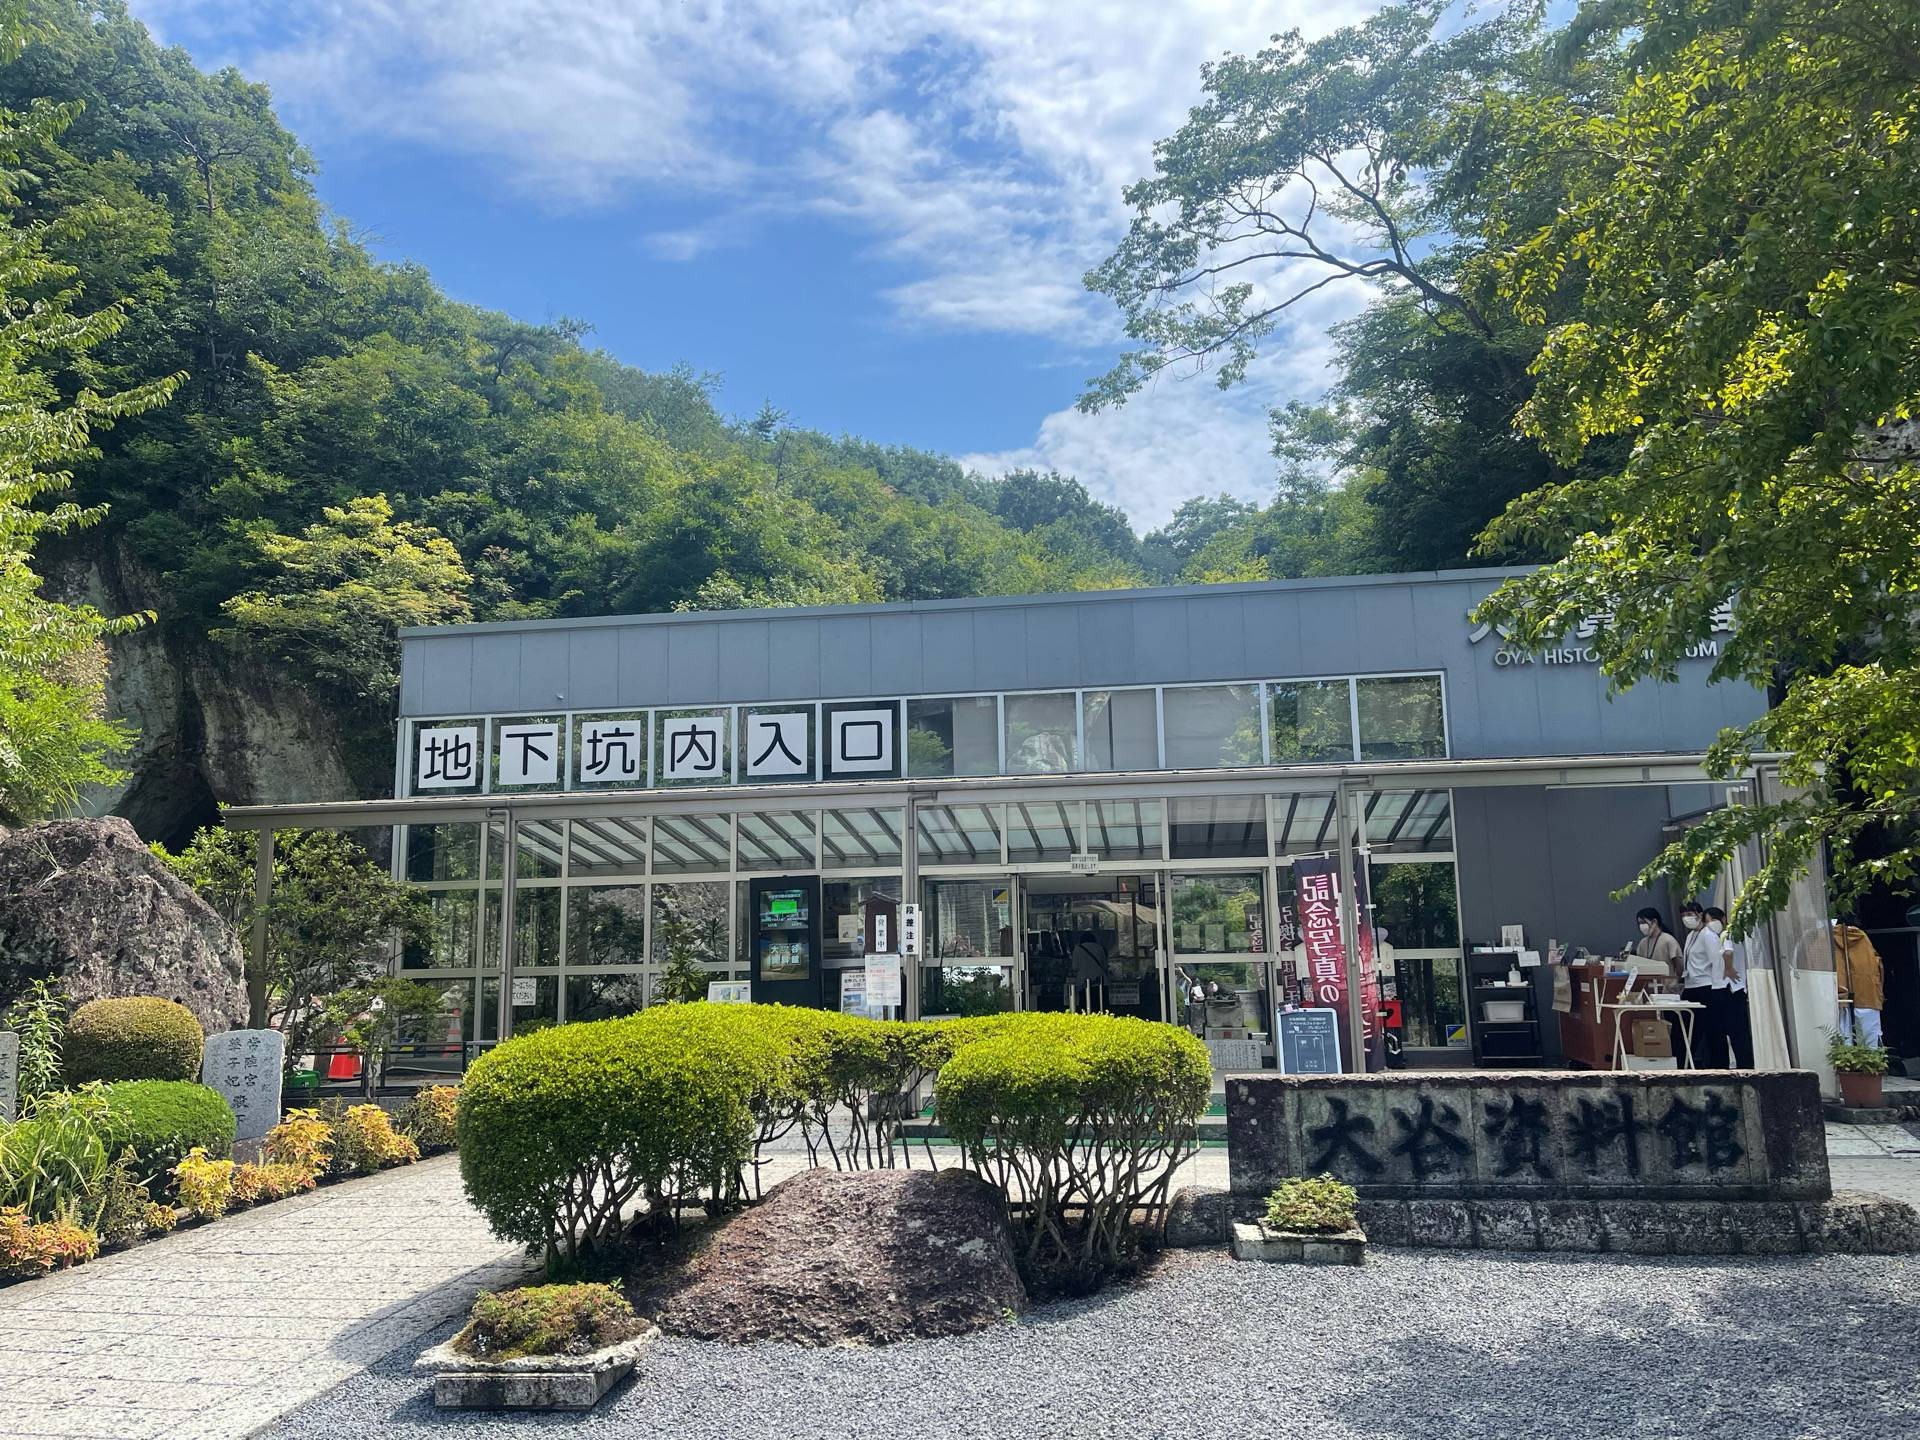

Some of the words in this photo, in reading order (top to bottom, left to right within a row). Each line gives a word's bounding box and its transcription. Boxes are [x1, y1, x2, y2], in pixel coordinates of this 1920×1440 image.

[1544, 646, 1612, 665] HISTO
[424, 720, 883, 781] 地下坑内入口
[905, 905, 915, 953] 段差注意
[1308, 1088, 1746, 1180] 大谷資料館
